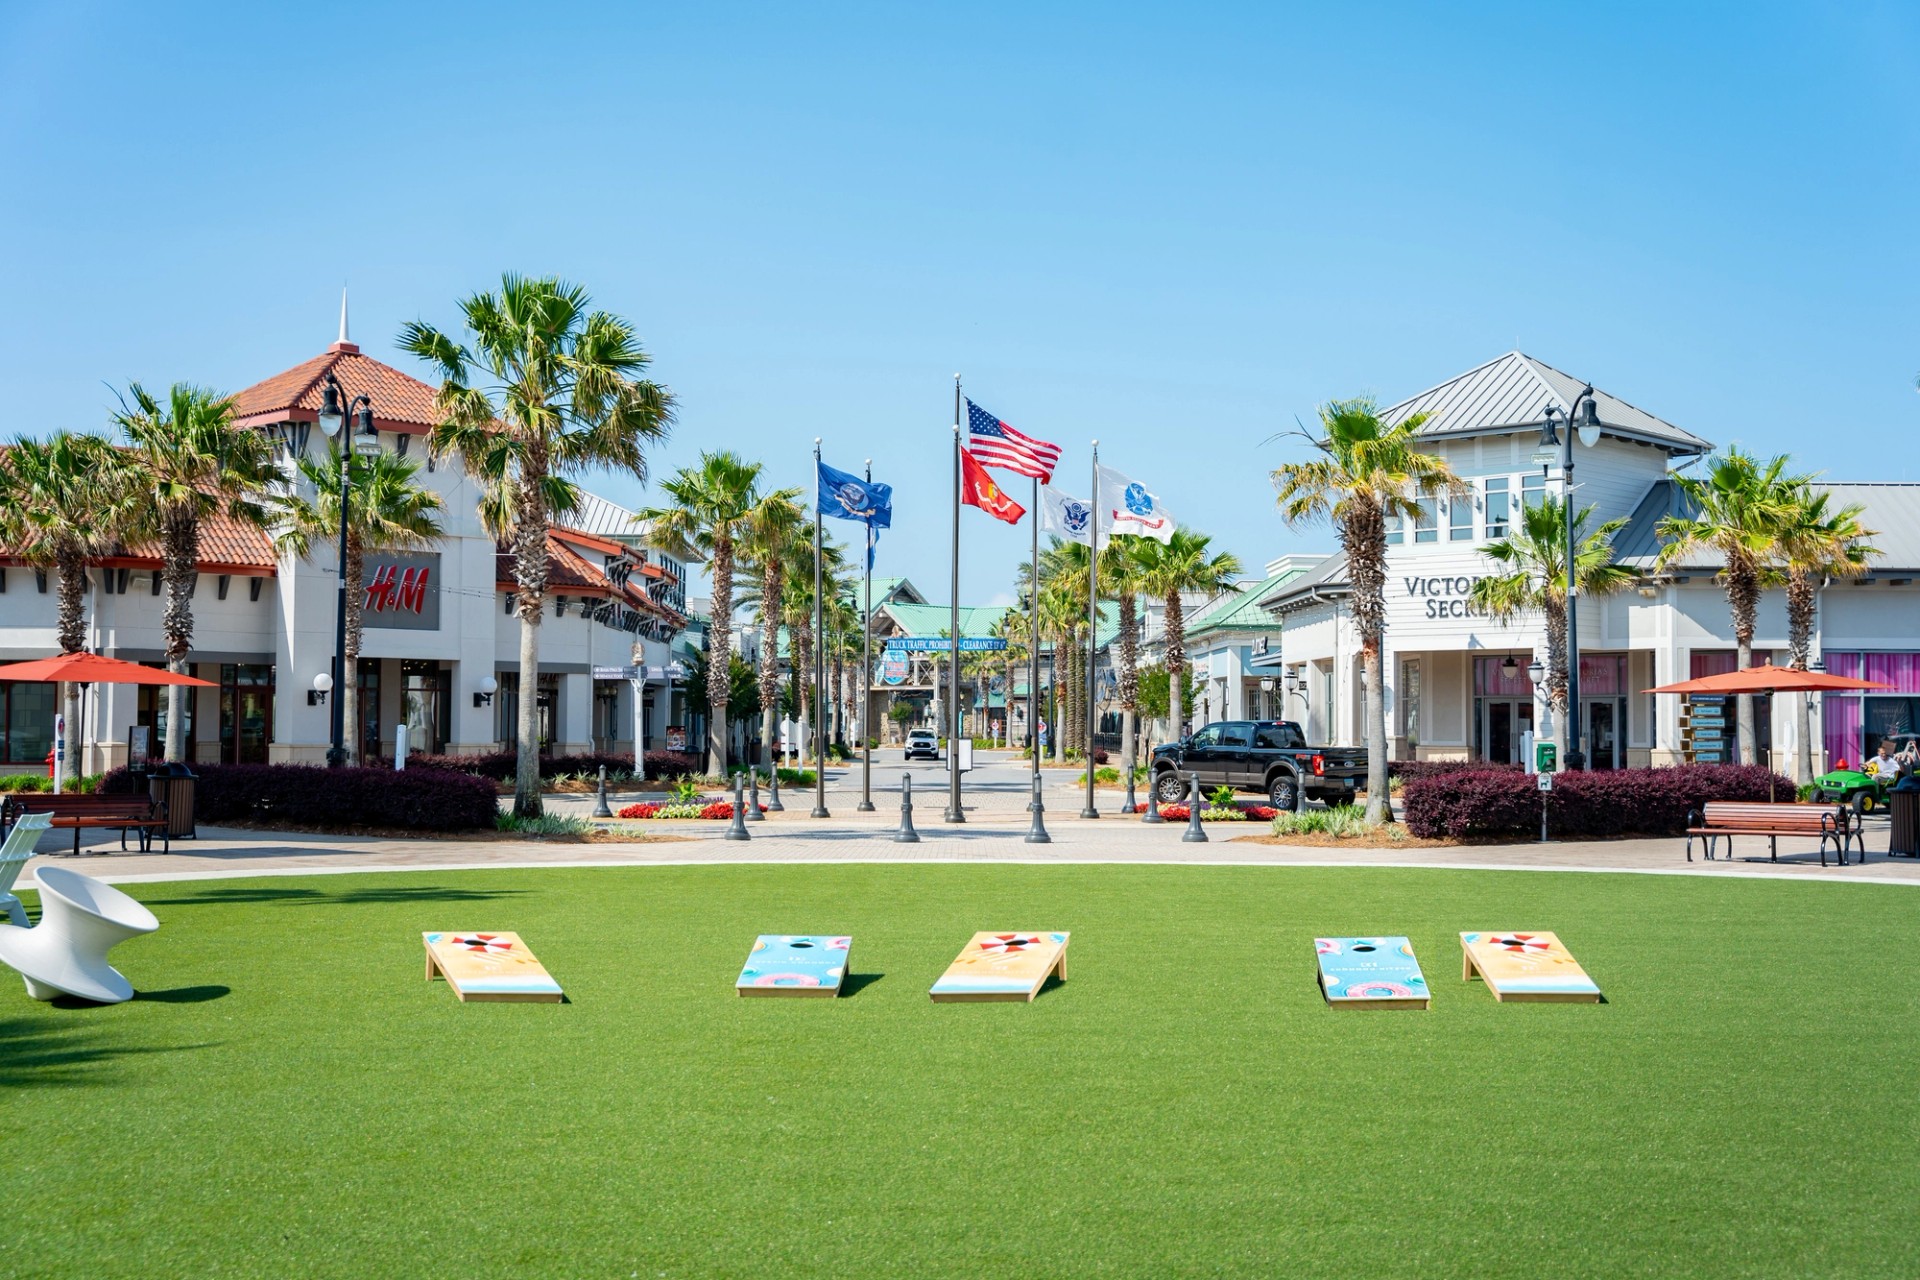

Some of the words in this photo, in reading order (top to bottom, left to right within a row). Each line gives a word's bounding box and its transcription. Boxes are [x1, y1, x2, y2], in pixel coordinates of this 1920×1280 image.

[364, 565, 430, 615] H&M
[1403, 576, 1482, 598] VICTO
[1425, 598, 1489, 619] SECR
[889, 640, 906, 649] TRUCK
[907, 640, 928, 649] TRAFFIC
[929, 640, 953, 649] PROHIBIT
[963, 640, 993, 650] CLEARANCE
